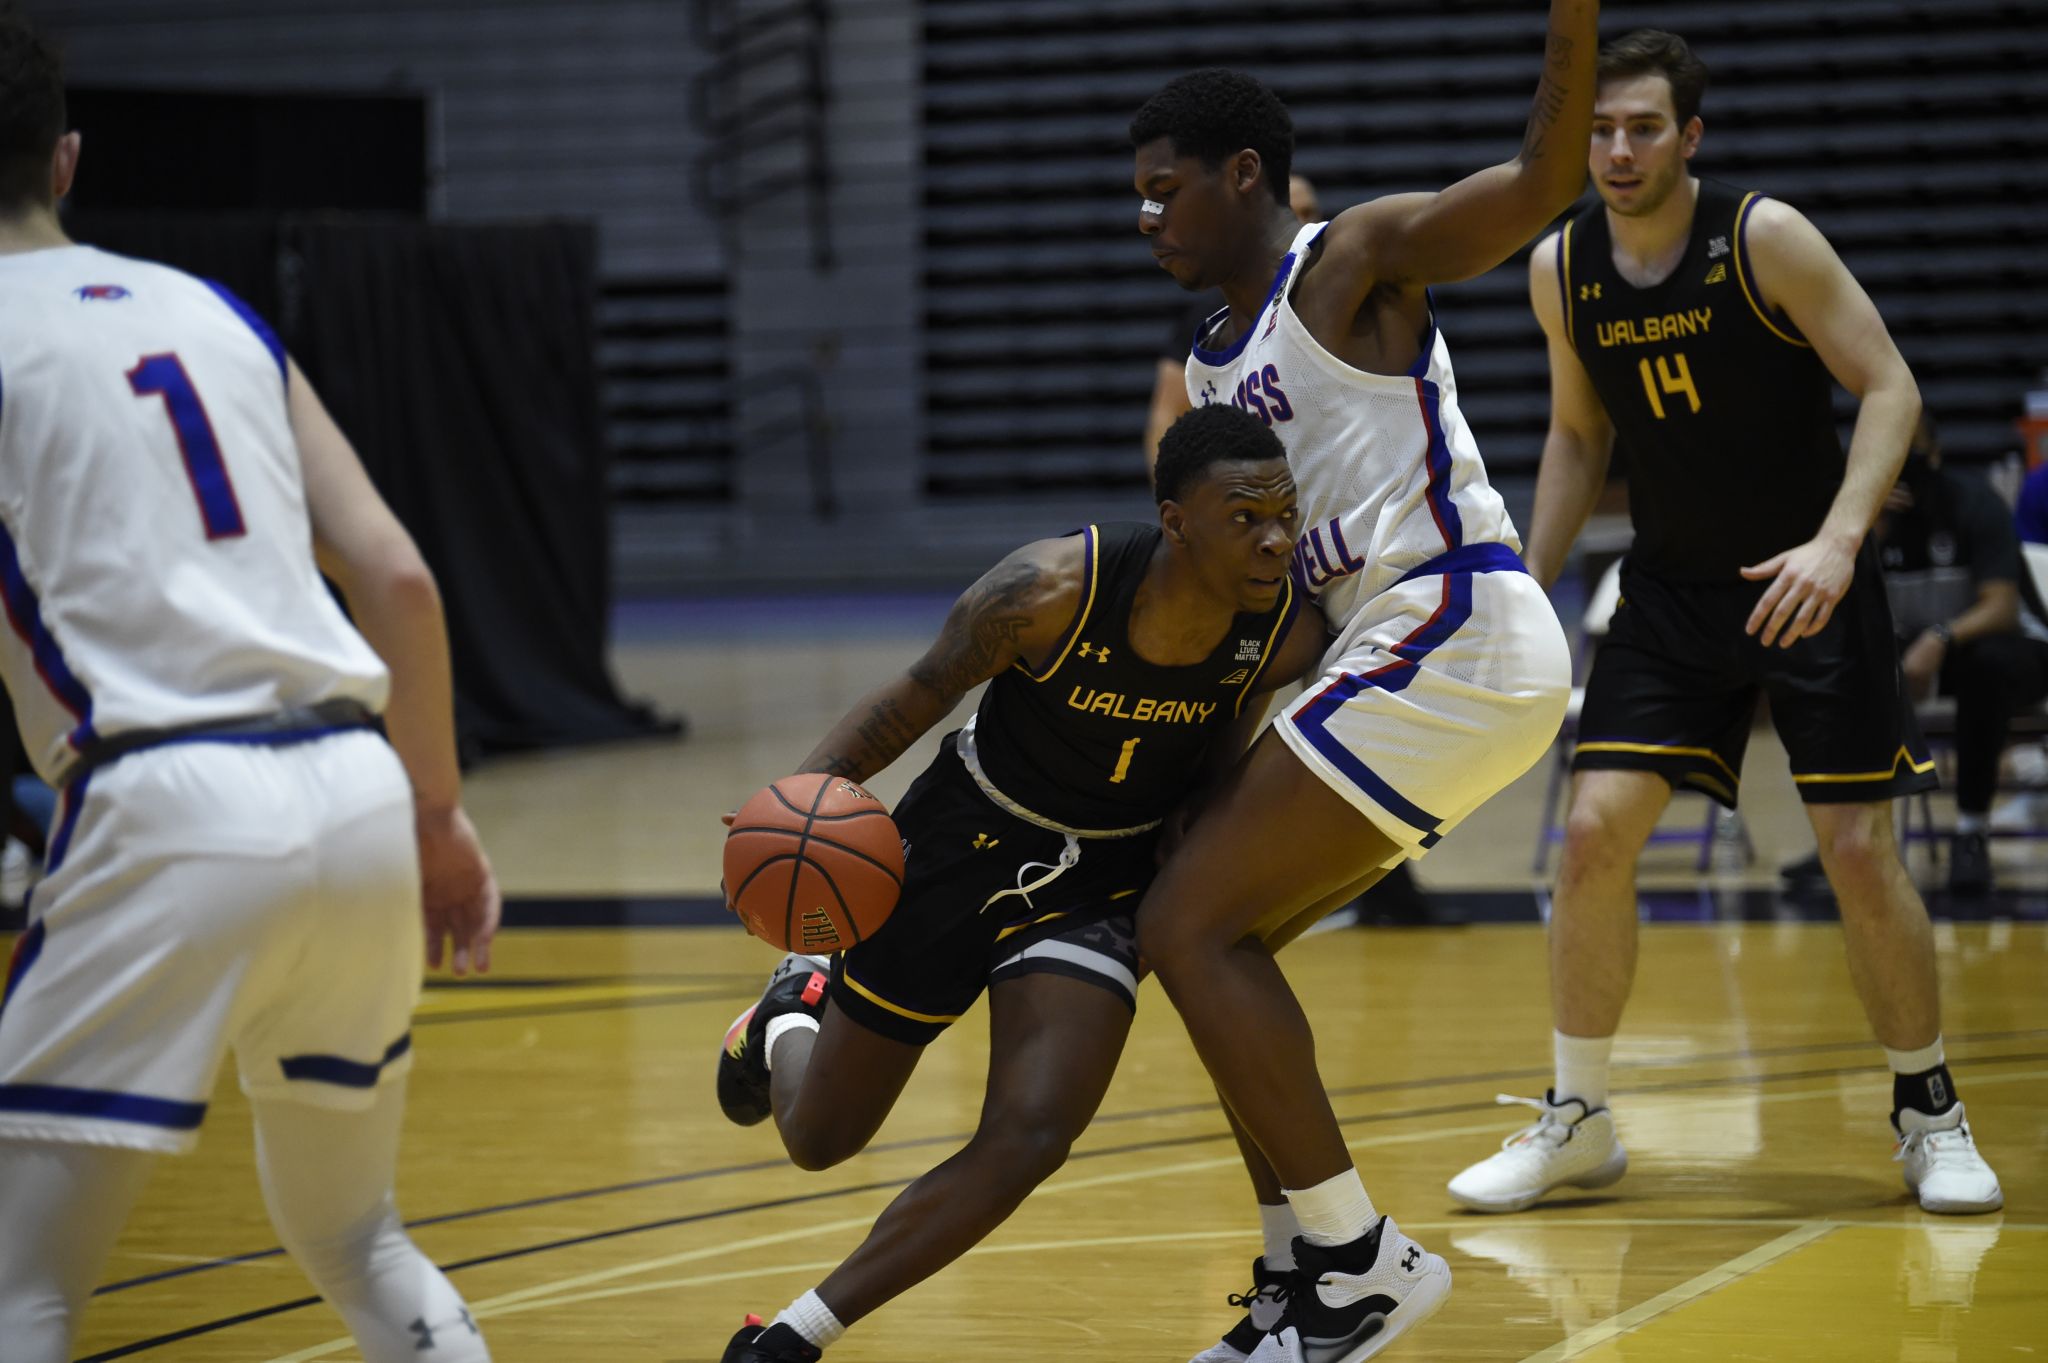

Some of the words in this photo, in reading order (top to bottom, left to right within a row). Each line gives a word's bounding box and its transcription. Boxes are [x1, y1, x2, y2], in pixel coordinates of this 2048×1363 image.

[1596, 306, 1713, 347] UALBANY
[1638, 352, 1701, 419] 14
[124, 351, 248, 543] 1
[1234, 653, 1261, 661] MATTER
[1240, 639, 1261, 647] BLACK
[1067, 685, 1217, 723] UALBANY
[1109, 737, 1141, 784] 1
[802, 906, 841, 947] THE
